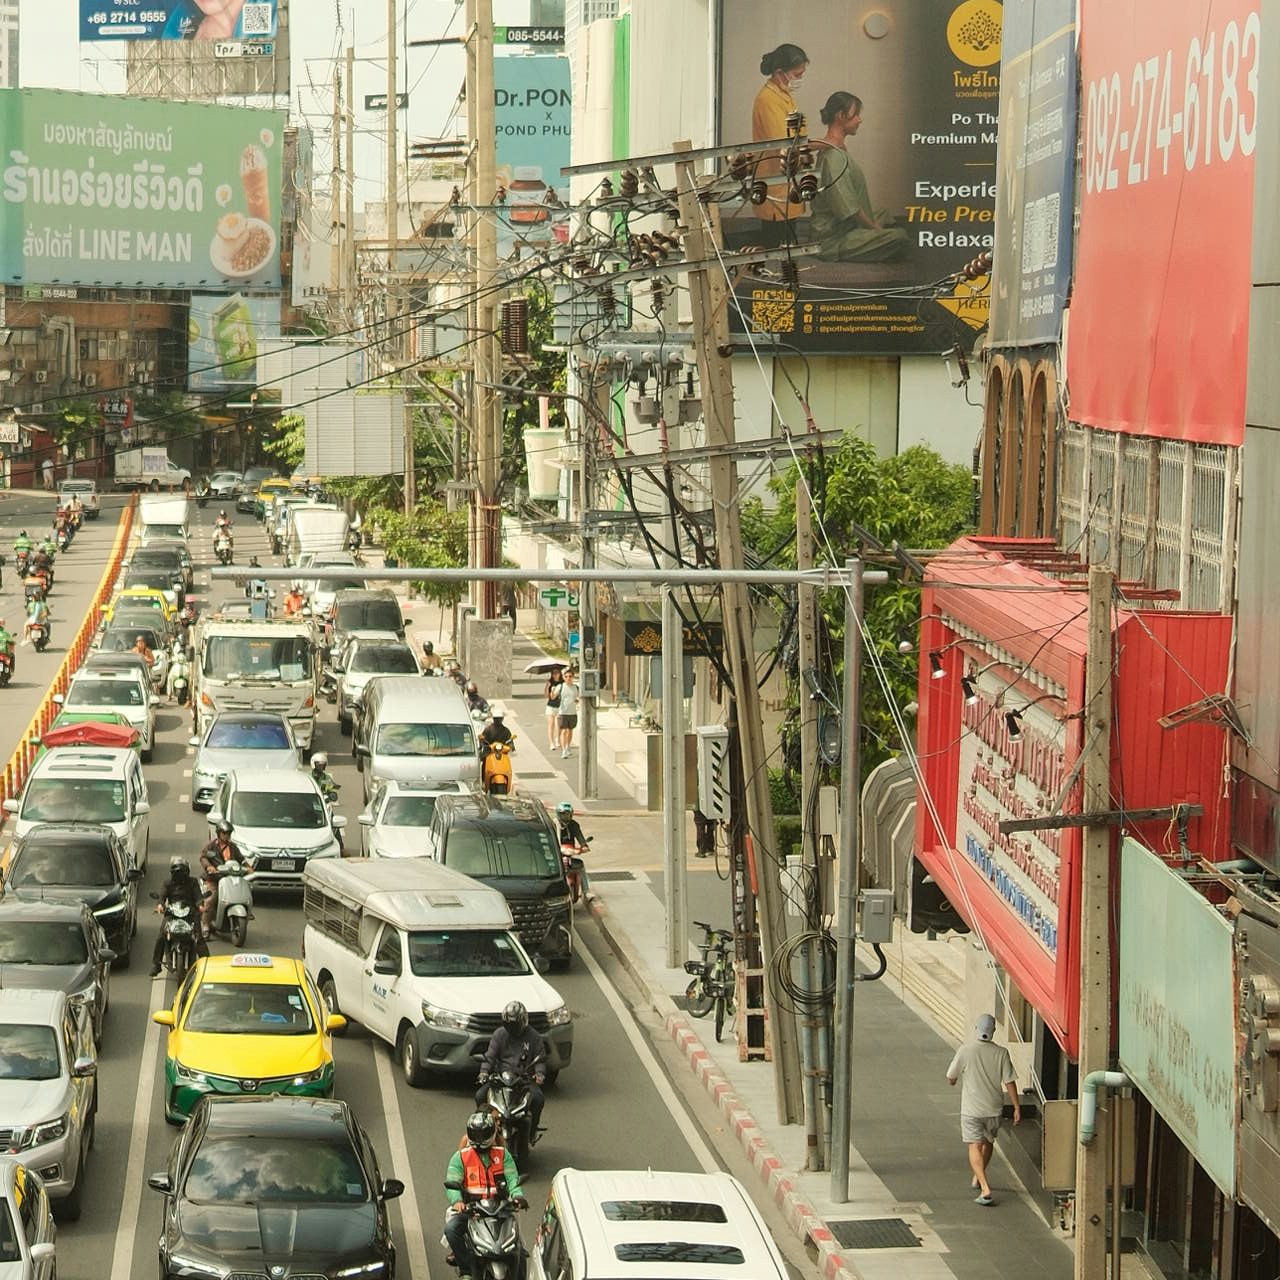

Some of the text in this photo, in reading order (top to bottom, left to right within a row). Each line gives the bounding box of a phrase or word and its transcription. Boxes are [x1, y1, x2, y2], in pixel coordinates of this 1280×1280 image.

[88, 11, 166, 24] +66 2714 9555
[953, 70, 1001, 87] โพธิ์ไท
[494, 89, 571, 107] Dr.PON
[1085, 10, 1261, 196] 092-274-6183
[952, 113, 971, 125] Po
[44, 121, 172, 155] มองหาสัญลักษณ์
[495, 125, 571, 135] POND PHU
[911, 133, 977, 144] Premium
[4, 150, 203, 212] ร้านอร่อยรีวิวดี
[915, 181, 997, 201] Experie
[904, 206, 996, 222] The Pre
[23, 223, 191, 262] สั่งได้ที่ LINE MAN
[918, 231, 993, 247] Relaxa
